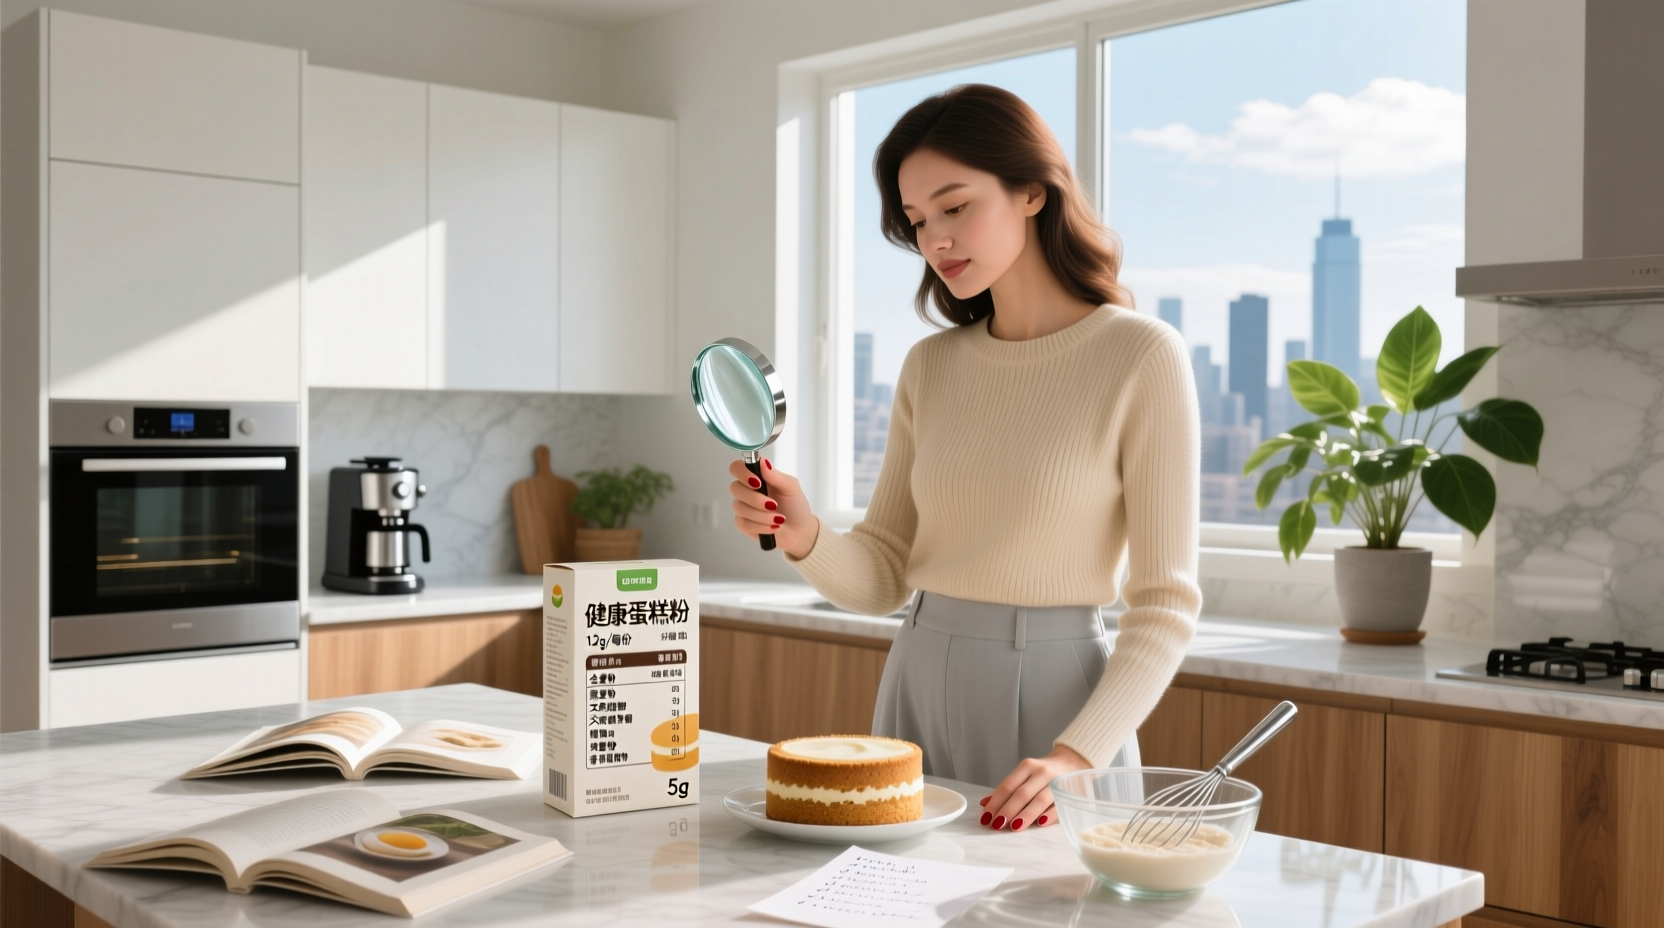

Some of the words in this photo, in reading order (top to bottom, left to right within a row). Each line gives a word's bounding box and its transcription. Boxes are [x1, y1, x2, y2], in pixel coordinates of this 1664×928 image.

[585, 599, 690, 628] 健康蛋糕粉
[667, 778, 689, 799] 5g
